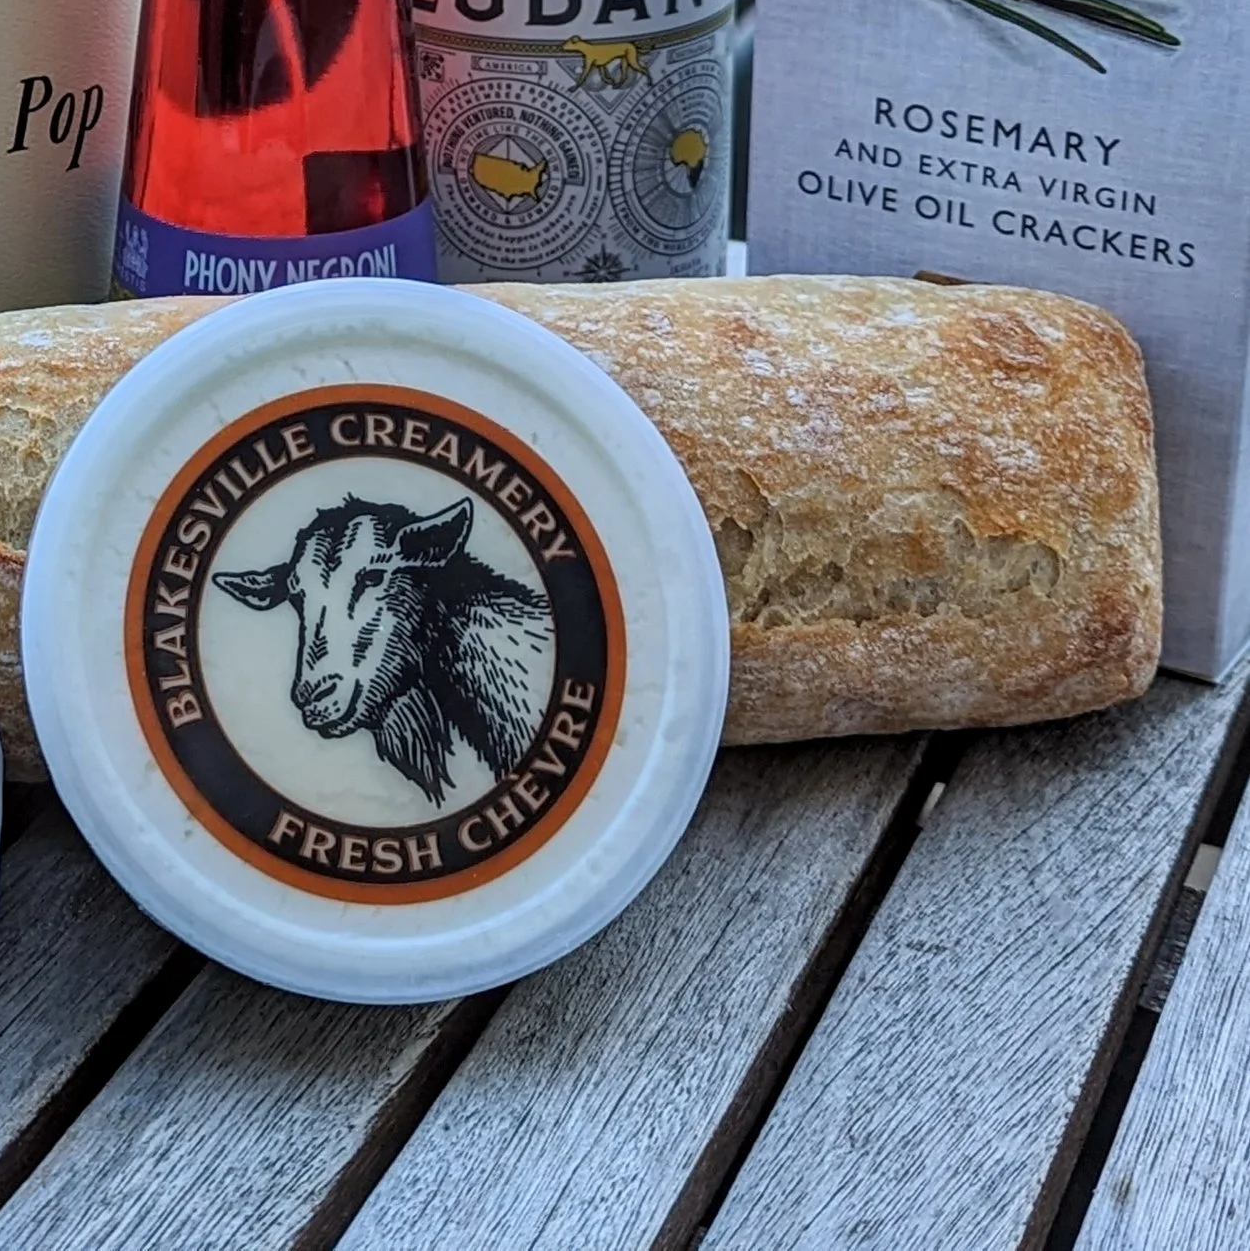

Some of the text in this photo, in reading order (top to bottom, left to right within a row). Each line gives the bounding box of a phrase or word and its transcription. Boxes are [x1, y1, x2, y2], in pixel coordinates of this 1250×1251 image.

[485, 60, 533, 73] AMERICA
[6, 75, 103, 172] Pop
[519, 108, 565, 142] NOTHING
[557, 139, 581, 180] GAINED
[873, 96, 1121, 168] ROSEMARY
[835, 138, 1156, 216] AND EXTRA VIRGIN
[797, 169, 1196, 268] OLIVE OIL CRACKERS
[184, 249, 278, 295] PHONY
[153, 411, 578, 731] BLAKESVILLE CREAMERY
[267, 678, 597, 874] FRESH CHÈVRE
